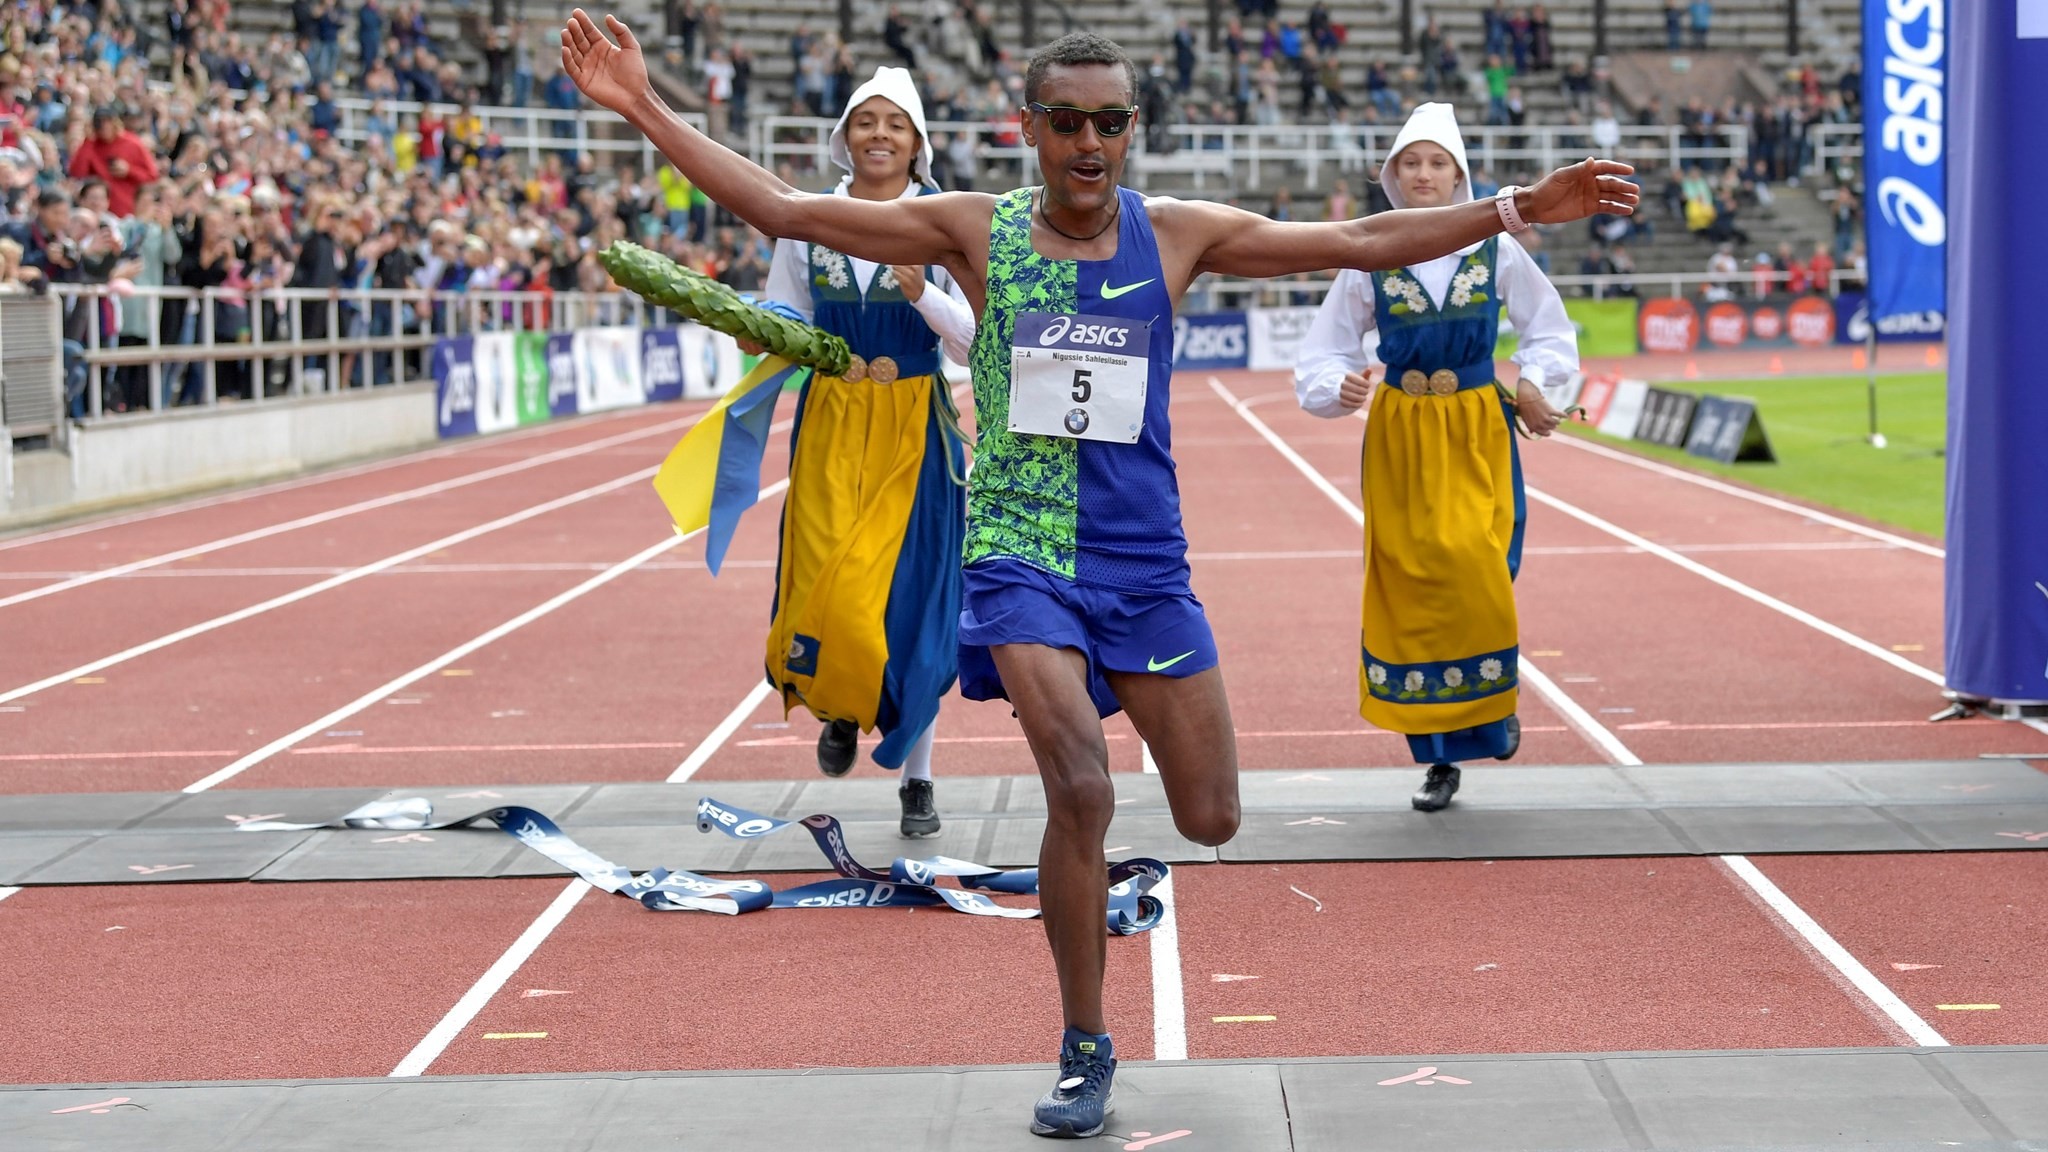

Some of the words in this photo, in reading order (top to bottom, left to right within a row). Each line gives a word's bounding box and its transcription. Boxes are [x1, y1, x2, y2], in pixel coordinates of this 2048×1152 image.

[1069, 323, 1129, 347] asics
[1052, 352, 1083, 362] Nigussie
[1071, 369, 1092, 403] 5
[826, 827, 860, 878] asics
